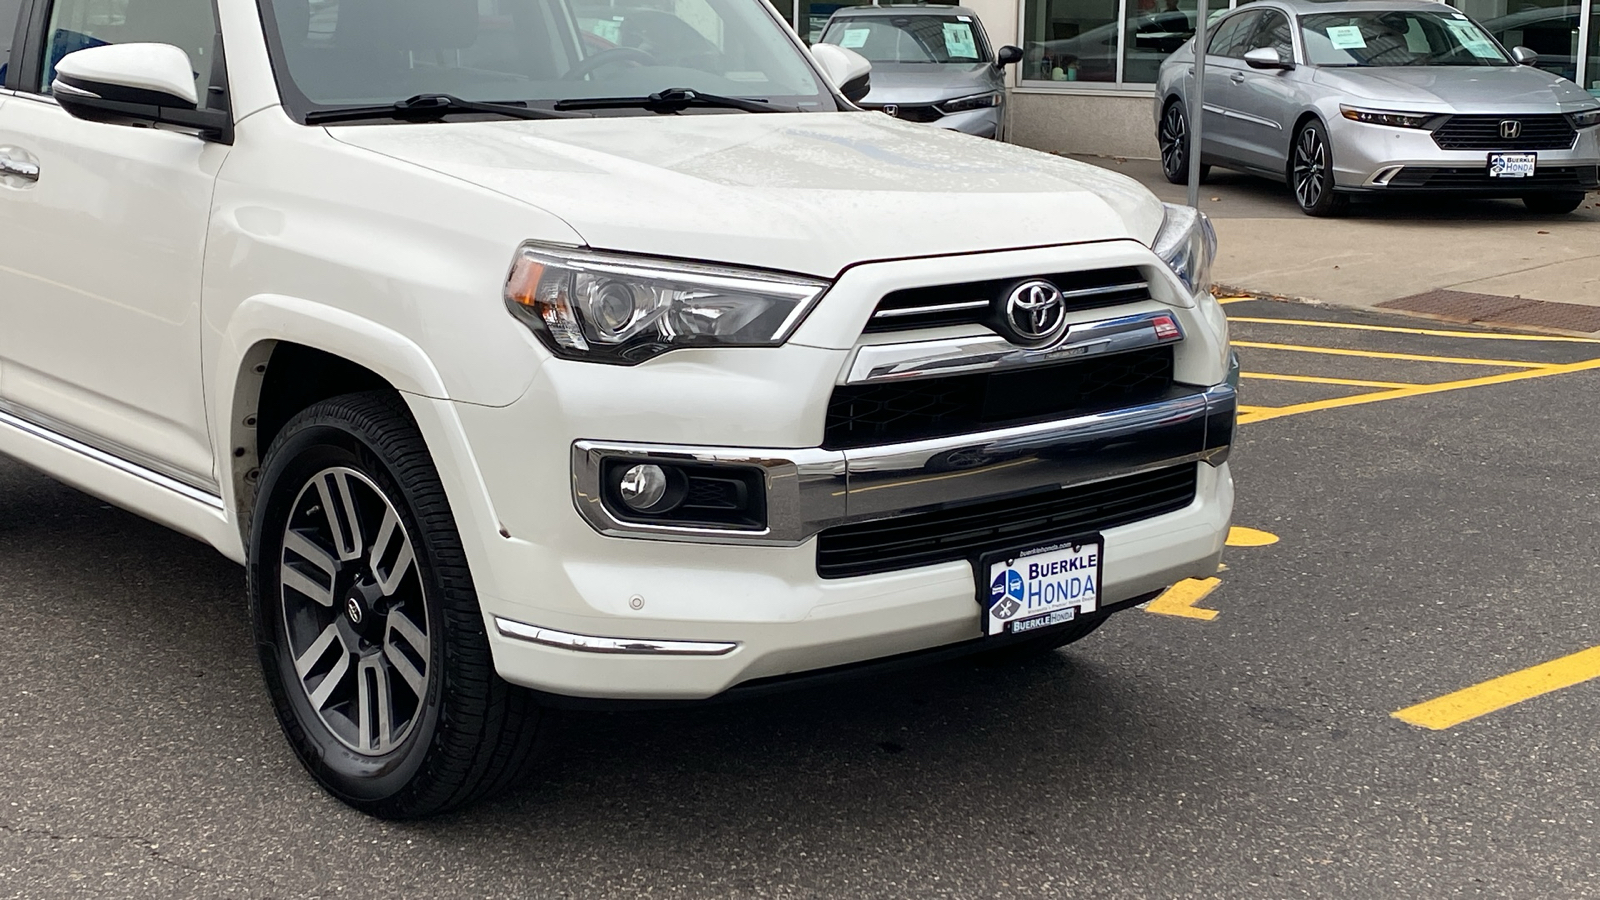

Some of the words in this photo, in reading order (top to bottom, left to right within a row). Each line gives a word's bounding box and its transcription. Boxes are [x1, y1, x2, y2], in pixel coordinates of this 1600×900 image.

[1506, 163, 1533, 171] HONDA
[1029, 554, 1096, 580] BUERKLE
[1028, 575, 1095, 609] HONDA
[1014, 615, 1051, 632] BUERKLE
[1051, 612, 1073, 623] HONDA
